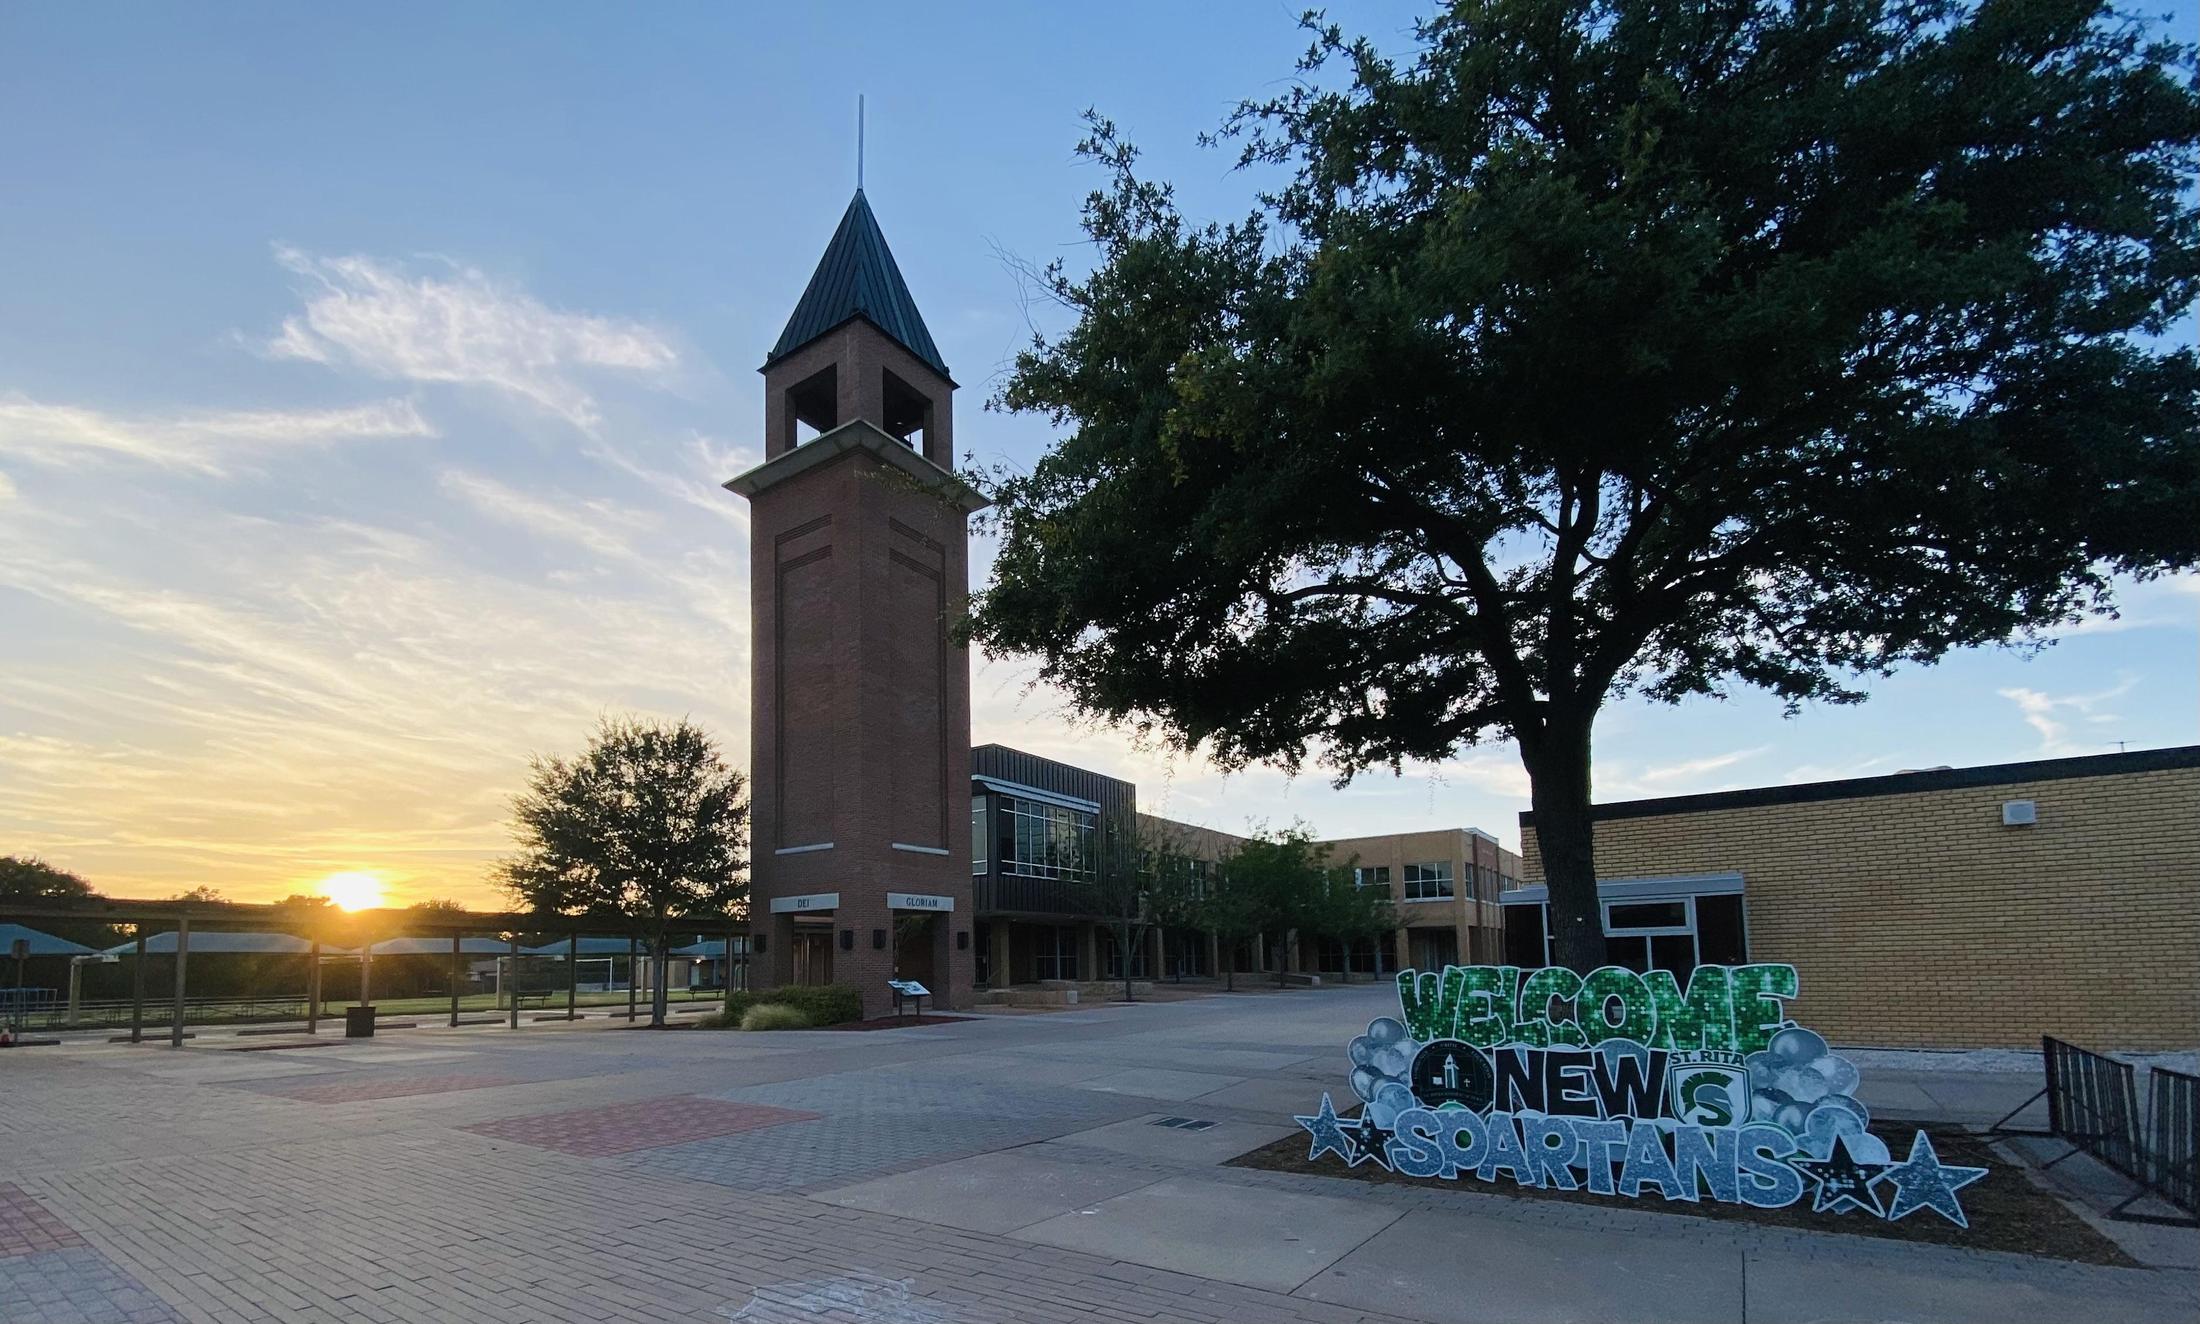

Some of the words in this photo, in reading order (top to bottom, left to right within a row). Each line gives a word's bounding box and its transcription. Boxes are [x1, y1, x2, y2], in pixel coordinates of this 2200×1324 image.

[797, 898, 810, 908] DEI
[905, 897, 938, 908] GLORIAM
[1396, 965, 1798, 1051] WELCOME
[1669, 1051, 1697, 1065] ST.
[1700, 1051, 1744, 1067] RITA
[1494, 1048, 1669, 1120] NEW
[1391, 1108, 1804, 1208] SPARTANS
